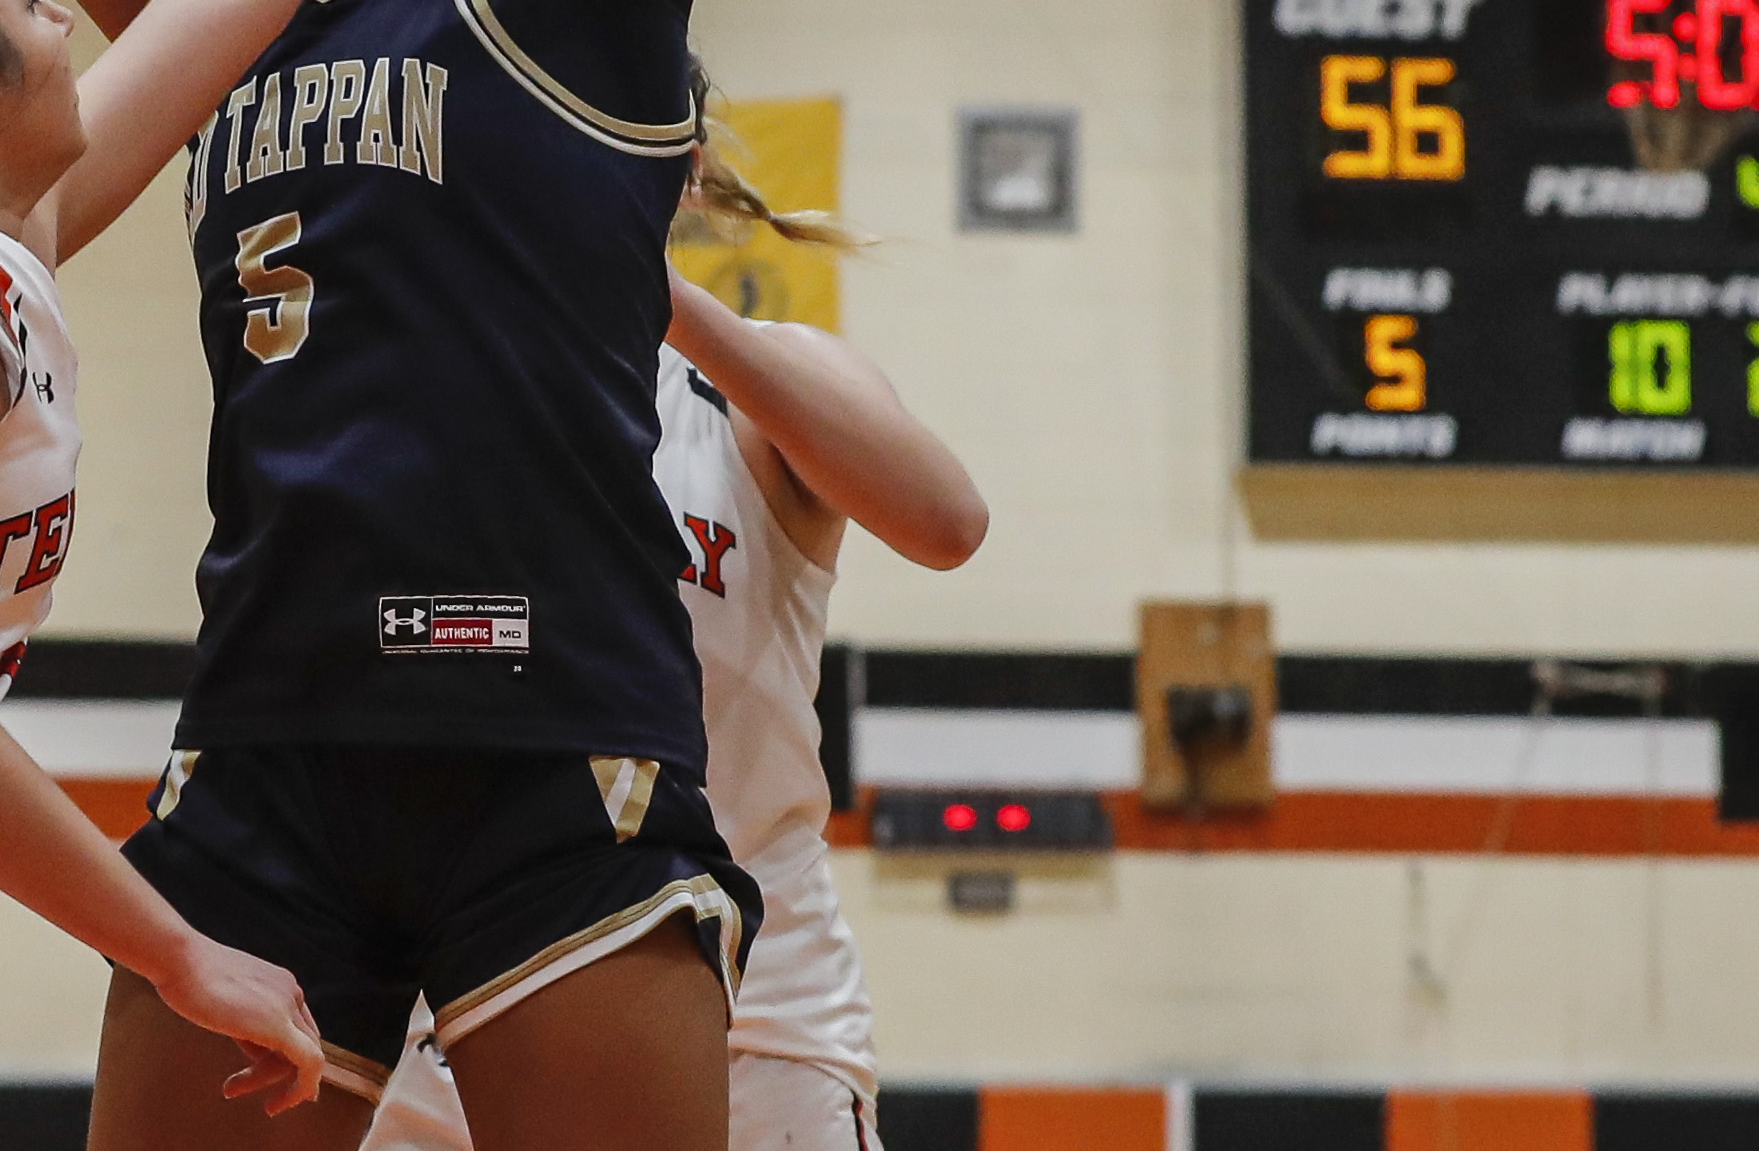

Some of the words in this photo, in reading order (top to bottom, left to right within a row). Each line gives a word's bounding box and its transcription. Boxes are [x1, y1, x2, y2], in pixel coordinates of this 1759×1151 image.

[225, 57, 448, 194] TAPPAN
[1320, 54, 1466, 181] 56
[1525, 165, 1710, 220] PERIOD
[235, 211, 315, 365] 5
[1322, 267, 1453, 313] FOULS
[1364, 314, 1427, 412] 5
[1607, 318, 1692, 416] 10
[1311, 412, 1458, 456] POINTS
[1561, 417, 1707, 461] MATCH
[434, 627, 490, 640] AUTHENTIC
[499, 630, 522, 639] MD
[435, 604, 474, 612] UNDER
[476, 604, 525, 612] ARMOUR
